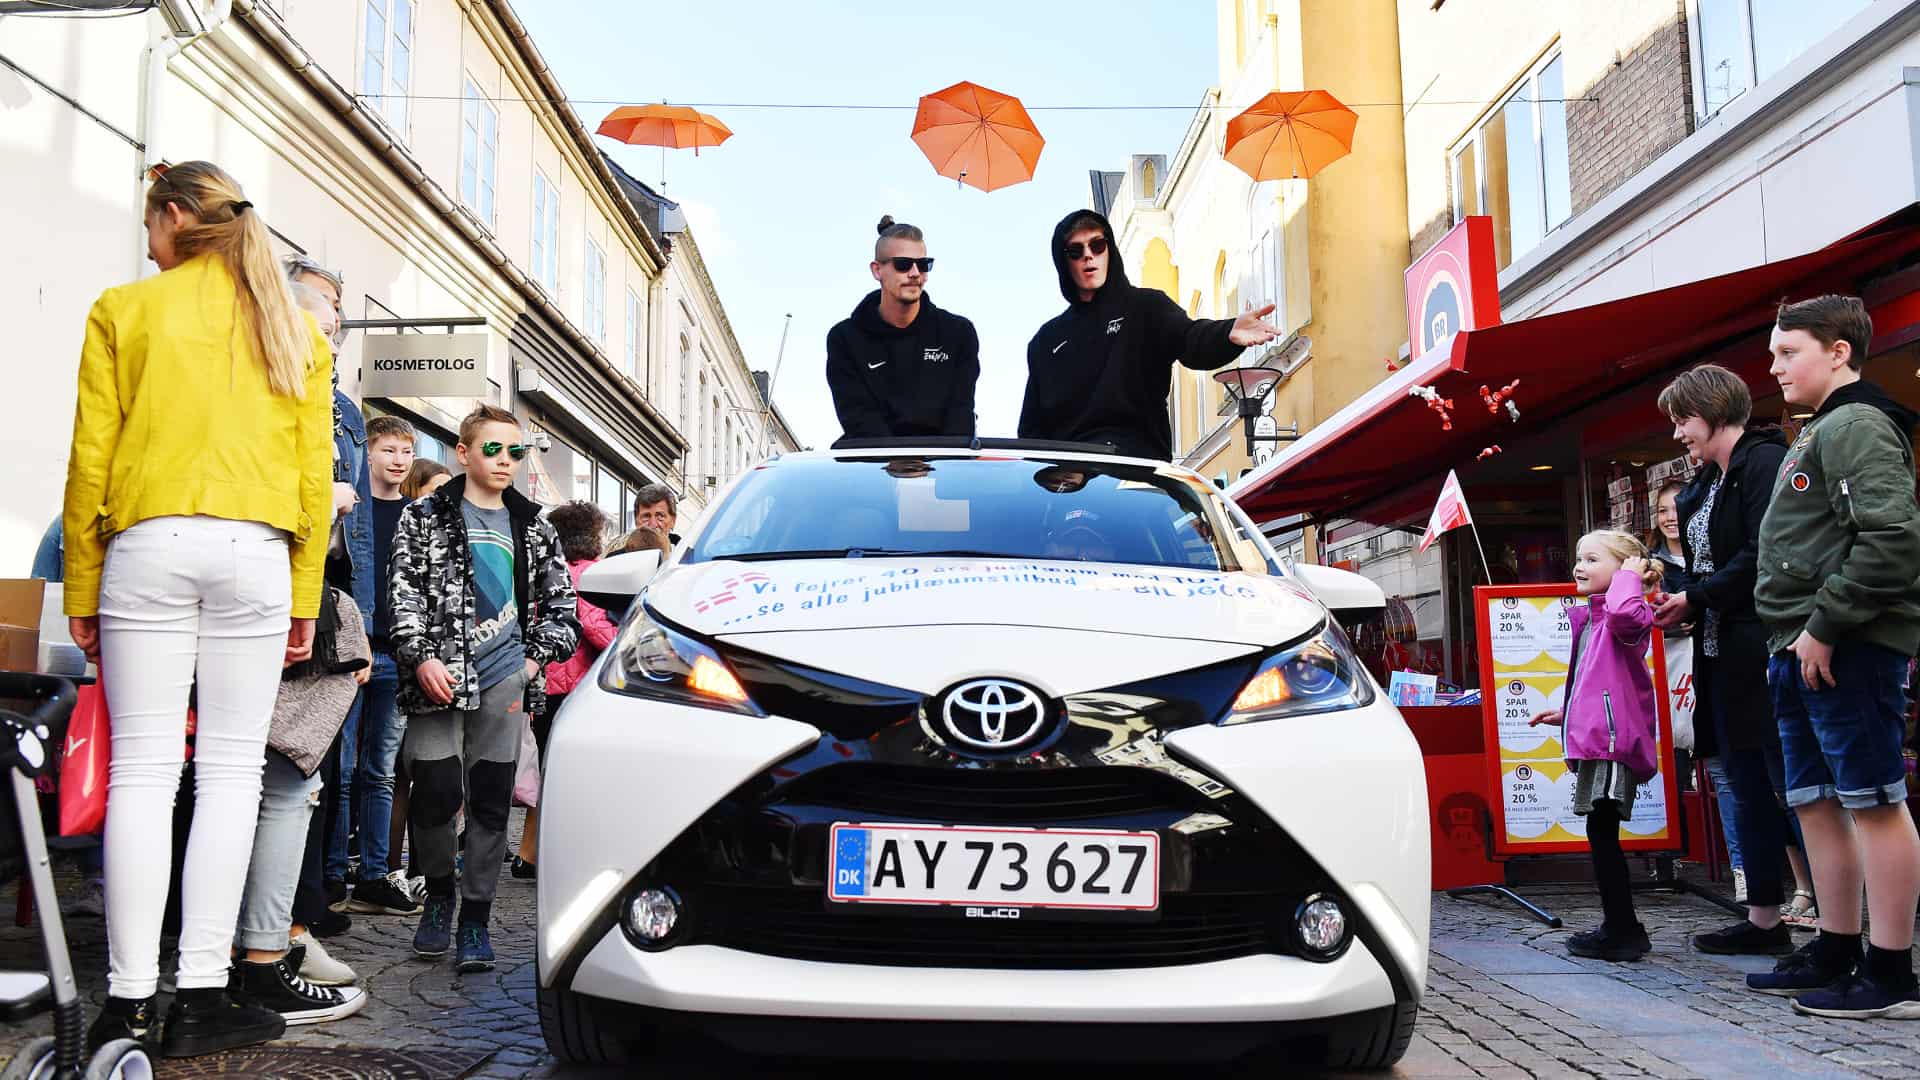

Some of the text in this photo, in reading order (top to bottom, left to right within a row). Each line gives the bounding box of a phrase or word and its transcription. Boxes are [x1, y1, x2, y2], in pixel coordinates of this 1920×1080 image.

[1434, 317, 1446, 338] BR
[374, 358, 475, 370] KOSMETOLOG
[753, 582, 777, 594] Vi
[881, 569, 918, 577] 40
[801, 594, 848, 608] alle
[1500, 612, 1521, 620] SPAR
[1500, 622, 1525, 632] 20 %
[1506, 698, 1528, 706] SPAR
[1505, 708, 1530, 718] 20 %
[1512, 783, 1535, 792] SPAR
[1512, 793, 1538, 803] 20 %
[873, 839, 1148, 894] AY 73 627
[839, 871, 861, 884] DK
